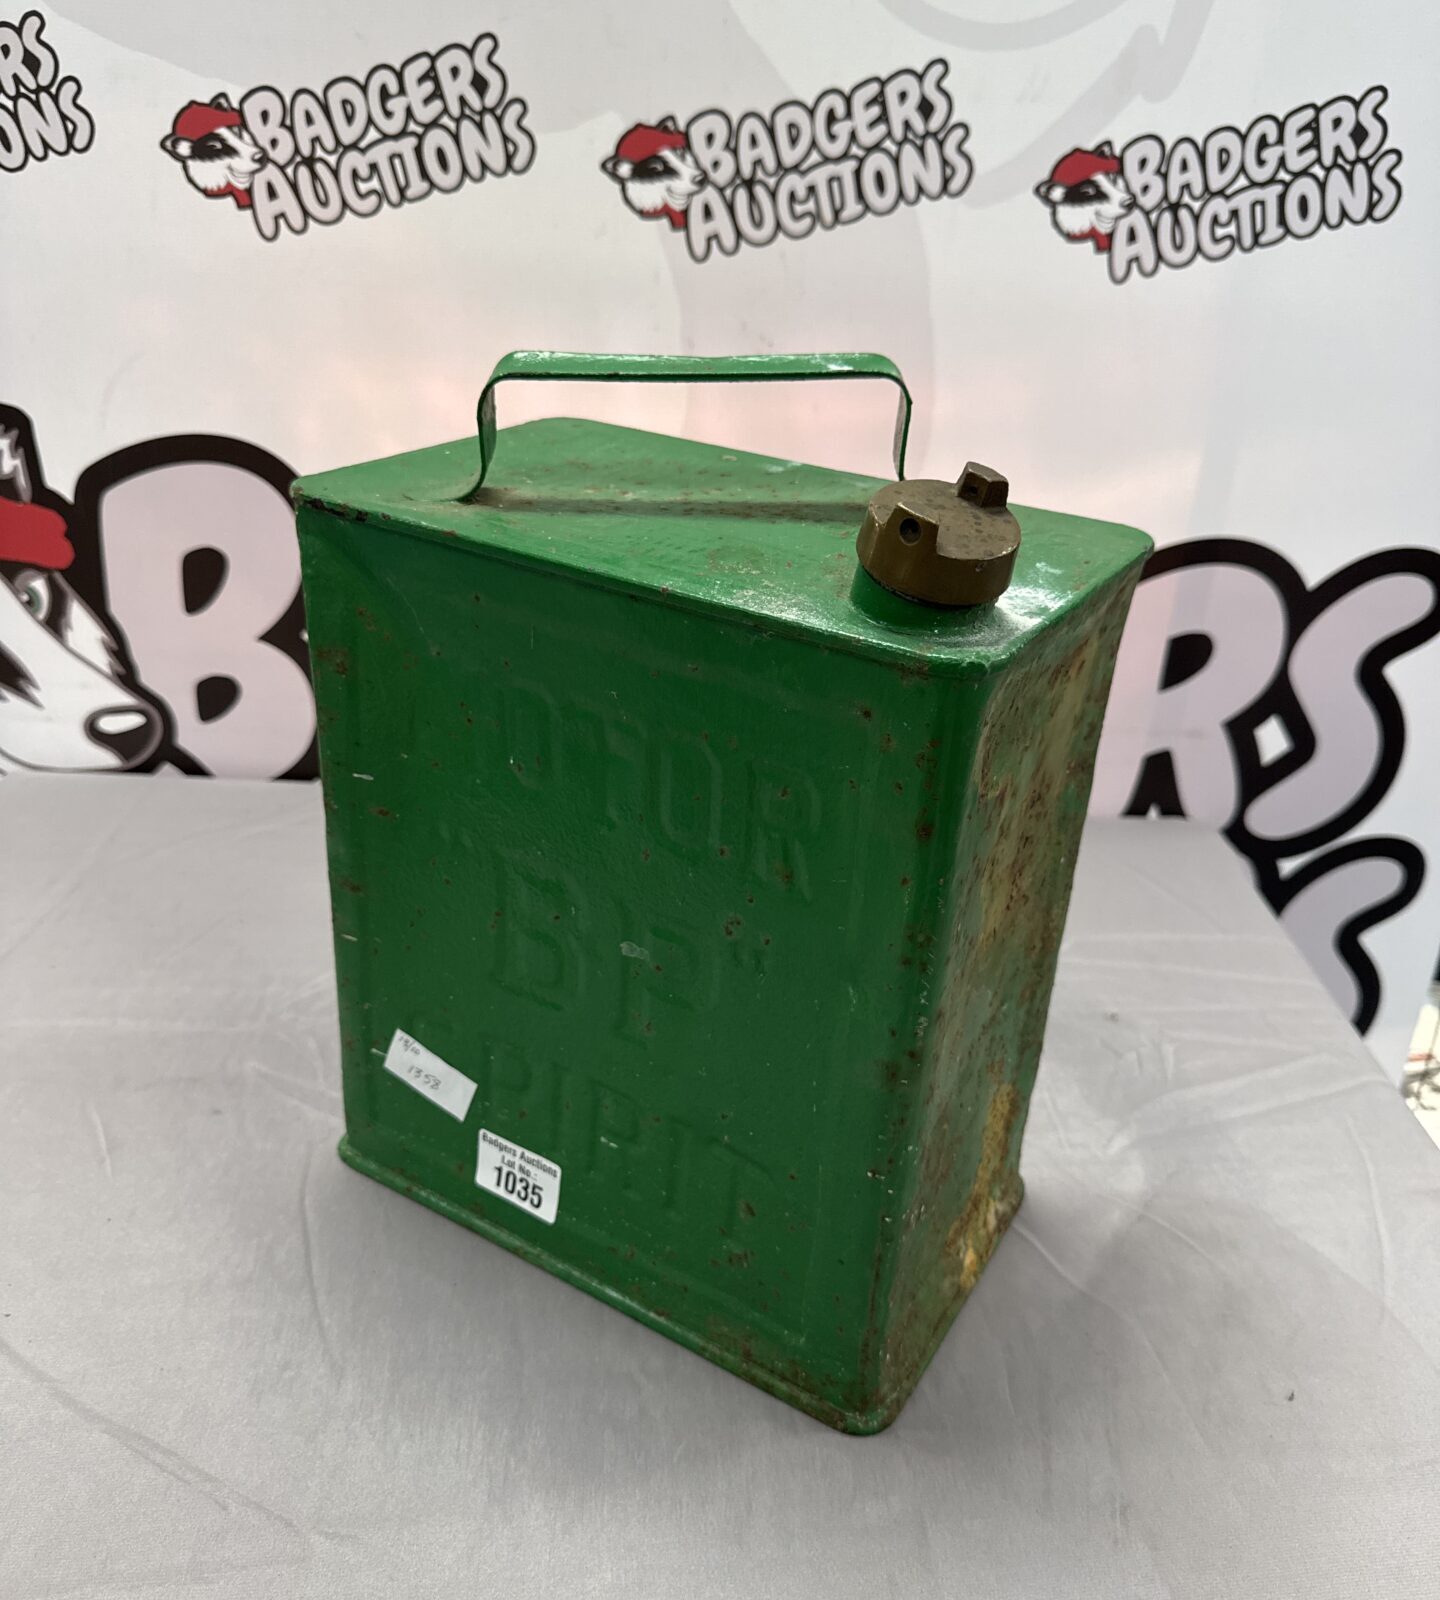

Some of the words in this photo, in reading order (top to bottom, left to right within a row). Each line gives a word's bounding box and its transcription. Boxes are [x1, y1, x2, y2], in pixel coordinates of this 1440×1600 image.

[240, 33, 507, 169] BADGERS
[685, 58, 953, 190] BADGERS
[1121, 85, 1389, 212] BADGERS
[251, 97, 537, 242] AUCTIONS
[685, 122, 973, 263] AUCTIONS
[1107, 148, 1403, 286] AUCTIONS
[408, 672, 823, 903] OTOR
[481, 1131, 517, 1157] Badgers
[519, 1151, 558, 1178] Auctions
[493, 1165, 544, 1209] 1035
[501, 1154, 516, 1170] Lot
